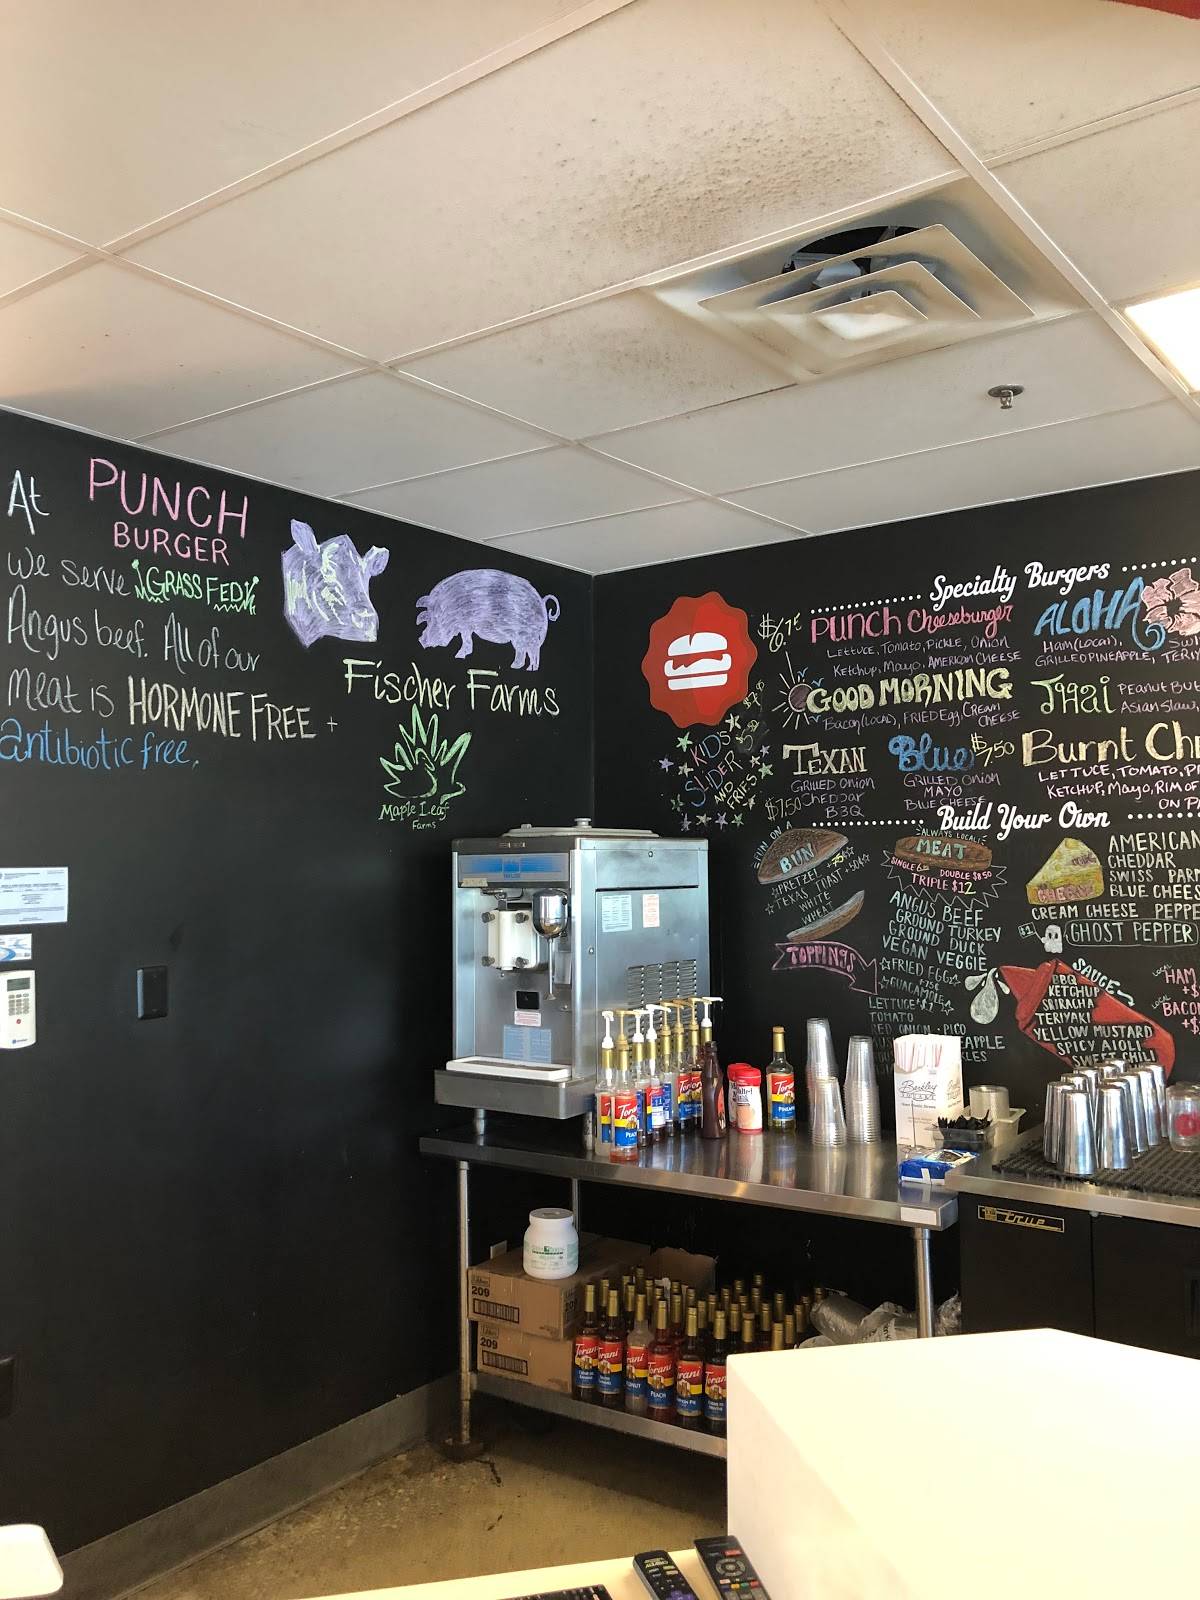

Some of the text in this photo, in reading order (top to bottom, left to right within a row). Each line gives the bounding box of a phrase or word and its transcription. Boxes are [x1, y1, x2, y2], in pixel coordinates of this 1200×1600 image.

[7, 469, 50, 535] At
[88, 457, 249, 538] PUNCH
[113, 521, 230, 566] BURGER
[7, 547, 244, 605] We serve GRASS FED
[929, 561, 1111, 612] Specialty Burgers
[907, 604, 1014, 639] Cheeseburger
[1034, 576, 1155, 646] ALOHA
[7, 583, 260, 674] Angus beef. All of our
[1169, 635, 1200, 648] SWI
[342, 658, 560, 716] Fischer Farms
[806, 684, 875, 714] GOOD
[879, 667, 1013, 708] MORNING
[91, 683, 114, 718] is
[128, 675, 245, 738] HORMONE
[251, 693, 317, 743] FREE
[0, 718, 135, 770] antibiotic
[887, 732, 975, 773] Blue
[1021, 727, 1137, 767] Burnt
[684, 750, 743, 807] SLIDER
[904, 773, 958, 787] GRILLED
[1155, 780, 1183, 795] RIM
[714, 781, 734, 805] AND
[924, 786, 963, 798] MAYO
[378, 801, 416, 821] Maple
[937, 801, 1111, 841] Build Your Own
[412, 819, 437, 830] Farms
[770, 826, 782, 840] ON
[921, 828, 952, 838] ALWAYS
[778, 843, 815, 874] BUN
[916, 839, 967, 860] MEAT
[1108, 852, 1176, 869] CHEDDAR
[891, 857, 915, 871] SINGLE
[940, 870, 971, 880] DOUBLE
[777, 868, 822, 895] PRETZEL
[912, 872, 977, 895] TRIPLE $12
[1110, 869, 1154, 883] SWISS
[777, 888, 809, 911] TEXAS
[799, 890, 831, 913] WHITE
[1110, 884, 1149, 898] BLUE
[801, 901, 833, 925] WHEAT
[889, 890, 984, 927] ANGUS BEEF
[1031, 905, 1079, 921] CREAM
[1086, 903, 1138, 918] CHEESE
[896, 908, 1001, 943] GROUND TURKEY
[1071, 922, 1194, 944] GHOST PEPPER
[889, 919, 986, 956] GROUND DUCK
[882, 935, 988, 972] VEGAN VEGGIE
[892, 957, 924, 977] FRIED
[1072, 958, 1120, 994] SAUCE
[1165, 968, 1196, 984] HAM
[890, 976, 945, 1005] GUACAMOLE
[1052, 974, 1077, 985] BBQ
[1049, 985, 1100, 998] KETCHUP
[1042, 999, 1094, 1011] SRIRACHA
[870, 1012, 914, 1023] TOMATO
[1035, 1012, 1091, 1025] TERIYAKI
[943, 1023, 967, 1036] PICO
[1034, 1025, 1153, 1041] YELLOW MUSTARD
[1057, 1039, 1142, 1056] SPICY AIOLI
[1122, 1050, 1156, 1063] CHILI
[472, 1286, 490, 1297] 209
[480, 1337, 498, 1349] 209
